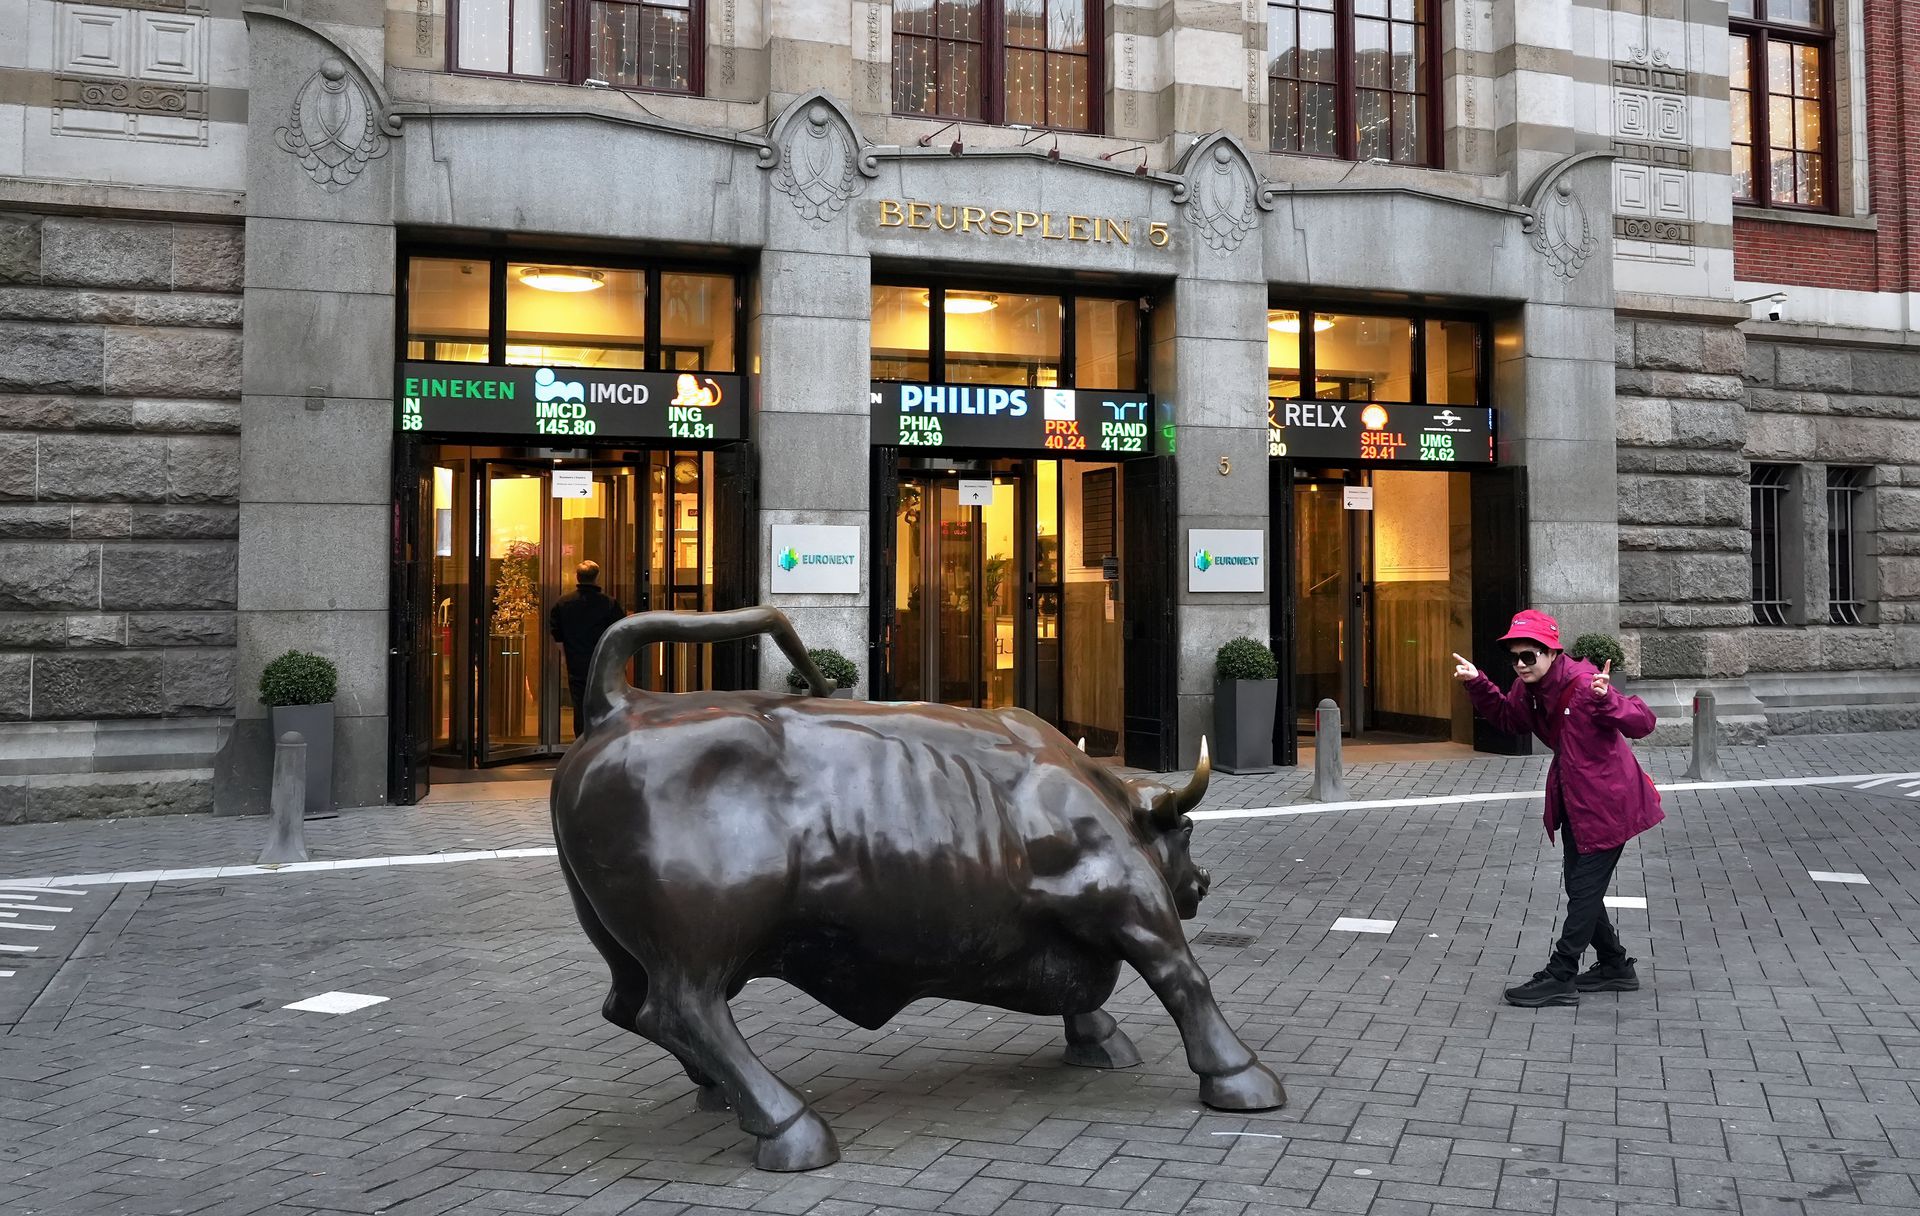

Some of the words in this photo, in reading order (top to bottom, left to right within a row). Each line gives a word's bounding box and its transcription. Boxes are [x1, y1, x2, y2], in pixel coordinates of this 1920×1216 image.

[879, 199, 1131, 246] BEURSPLEIN
[1148, 222, 1170, 247] 5
[405, 378, 515, 400] EINEKEN
[590, 383, 650, 406] IMCD
[870, 392, 883, 404] N
[901, 385, 1028, 417] PHILIPS
[535, 402, 587, 419] IMCD
[669, 406, 702, 422] ING
[1285, 403, 1347, 428] RELX
[403, 415, 423, 431] 68
[535, 419, 597, 436] 145.80
[668, 422, 715, 439] 14.81
[899, 415, 942, 431] PHIA
[1045, 420, 1079, 435] PRX
[1101, 422, 1148, 437] RAND
[899, 431, 943, 446] 24.39
[1044, 435, 1086, 450] 40.24
[1101, 436, 1142, 451] 41.22
[1361, 432, 1407, 447] SHELL
[1420, 433, 1452, 448] UMG
[1361, 445, 1396, 460] 29.41
[1420, 447, 1455, 461] 24.62
[1217, 456, 1232, 476] 5
[802, 554, 855, 565] EURONEXT
[1214, 556, 1259, 566] EURONEXT
